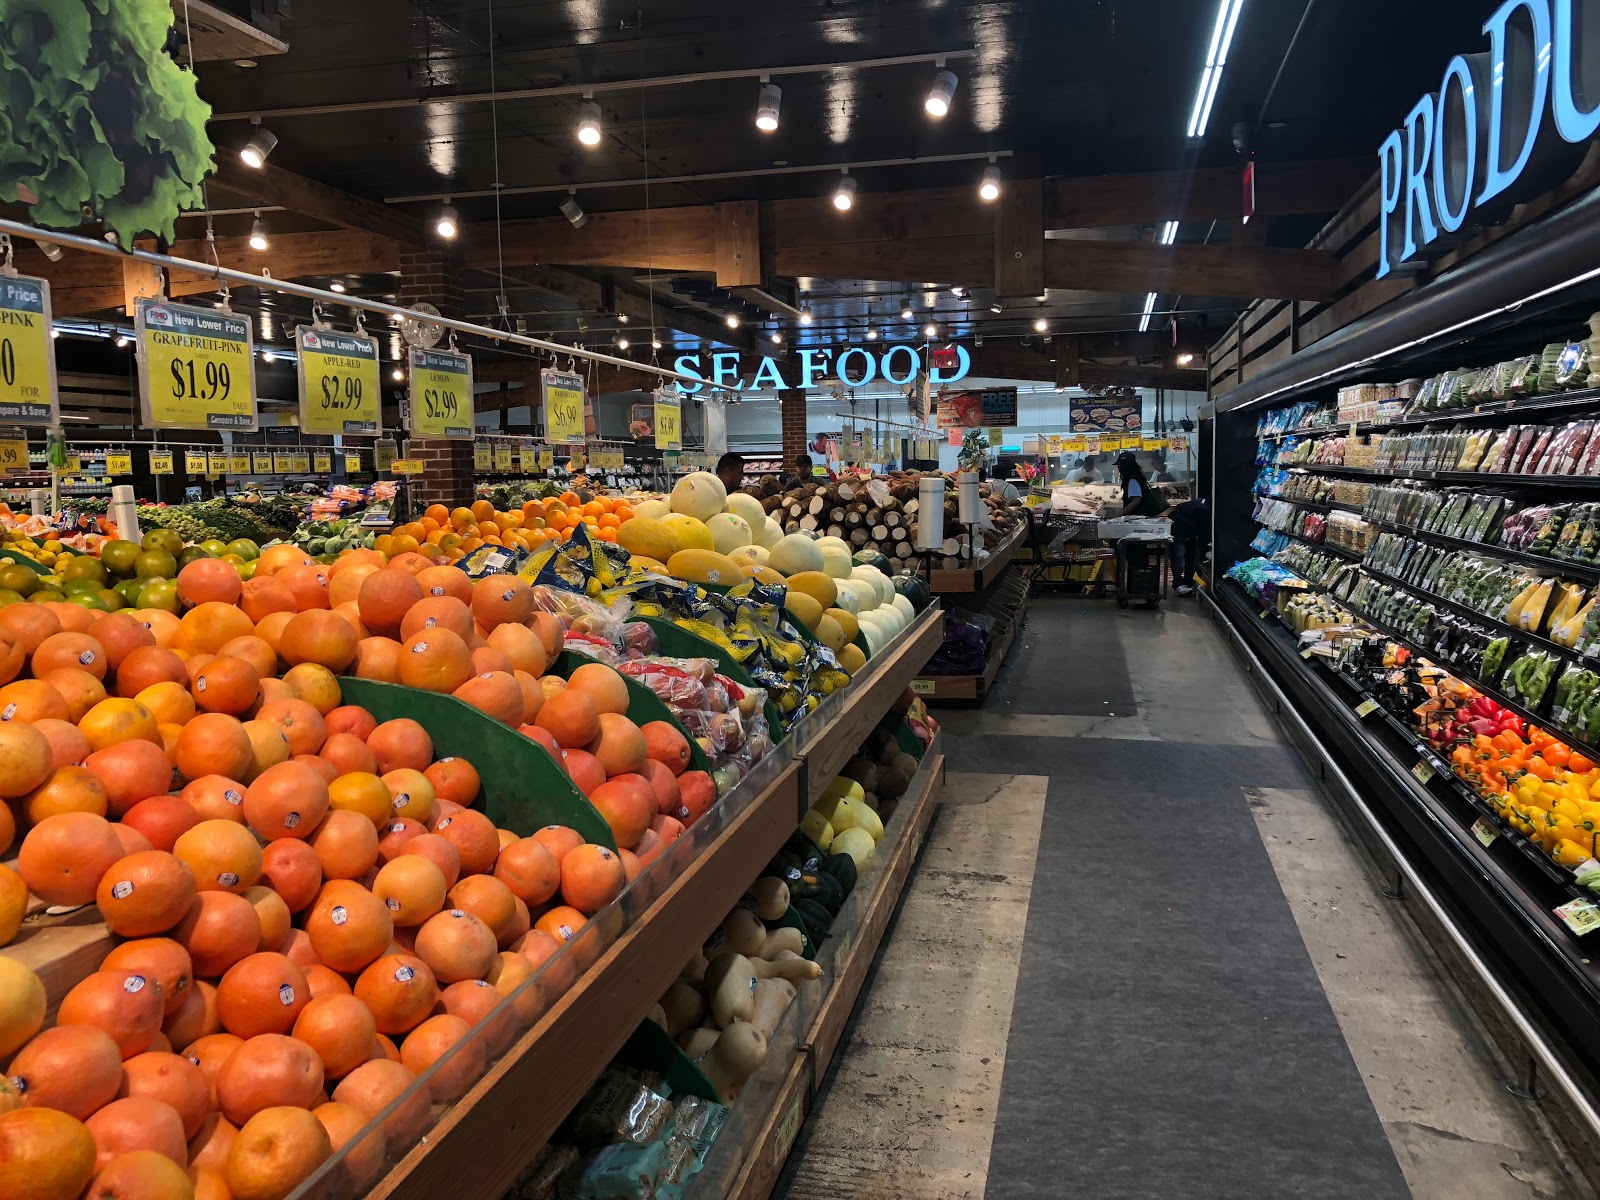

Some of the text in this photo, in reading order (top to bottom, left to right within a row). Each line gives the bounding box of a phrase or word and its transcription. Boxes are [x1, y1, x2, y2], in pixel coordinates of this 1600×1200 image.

[7, 285, 38, 303] Price
[174, 312, 245, 335] New Lower Price
[153, 332, 243, 354] GRAPEFRUIT-PINK
[321, 337, 373, 354] New Lower Price
[323, 356, 361, 369] APPLE-RED
[427, 355, 466, 369] New Lower Price
[673, 344, 971, 394] SEAFOOD
[170, 357, 231, 401] $1.99
[430, 373, 450, 384] LEMON
[20, 386, 40, 397] FOR
[321, 374, 363, 411] $2.99
[980, 392, 1015, 406] FREE
[21, 405, 28, 416] &
[29, 406, 47, 417] Save
[232, 401, 248, 410] EACH
[424, 388, 458, 420] $2.99
[553, 404, 577, 428] $6.99
[634, 409, 652, 418] FRESH
[111, 460, 126, 469] $1.49
